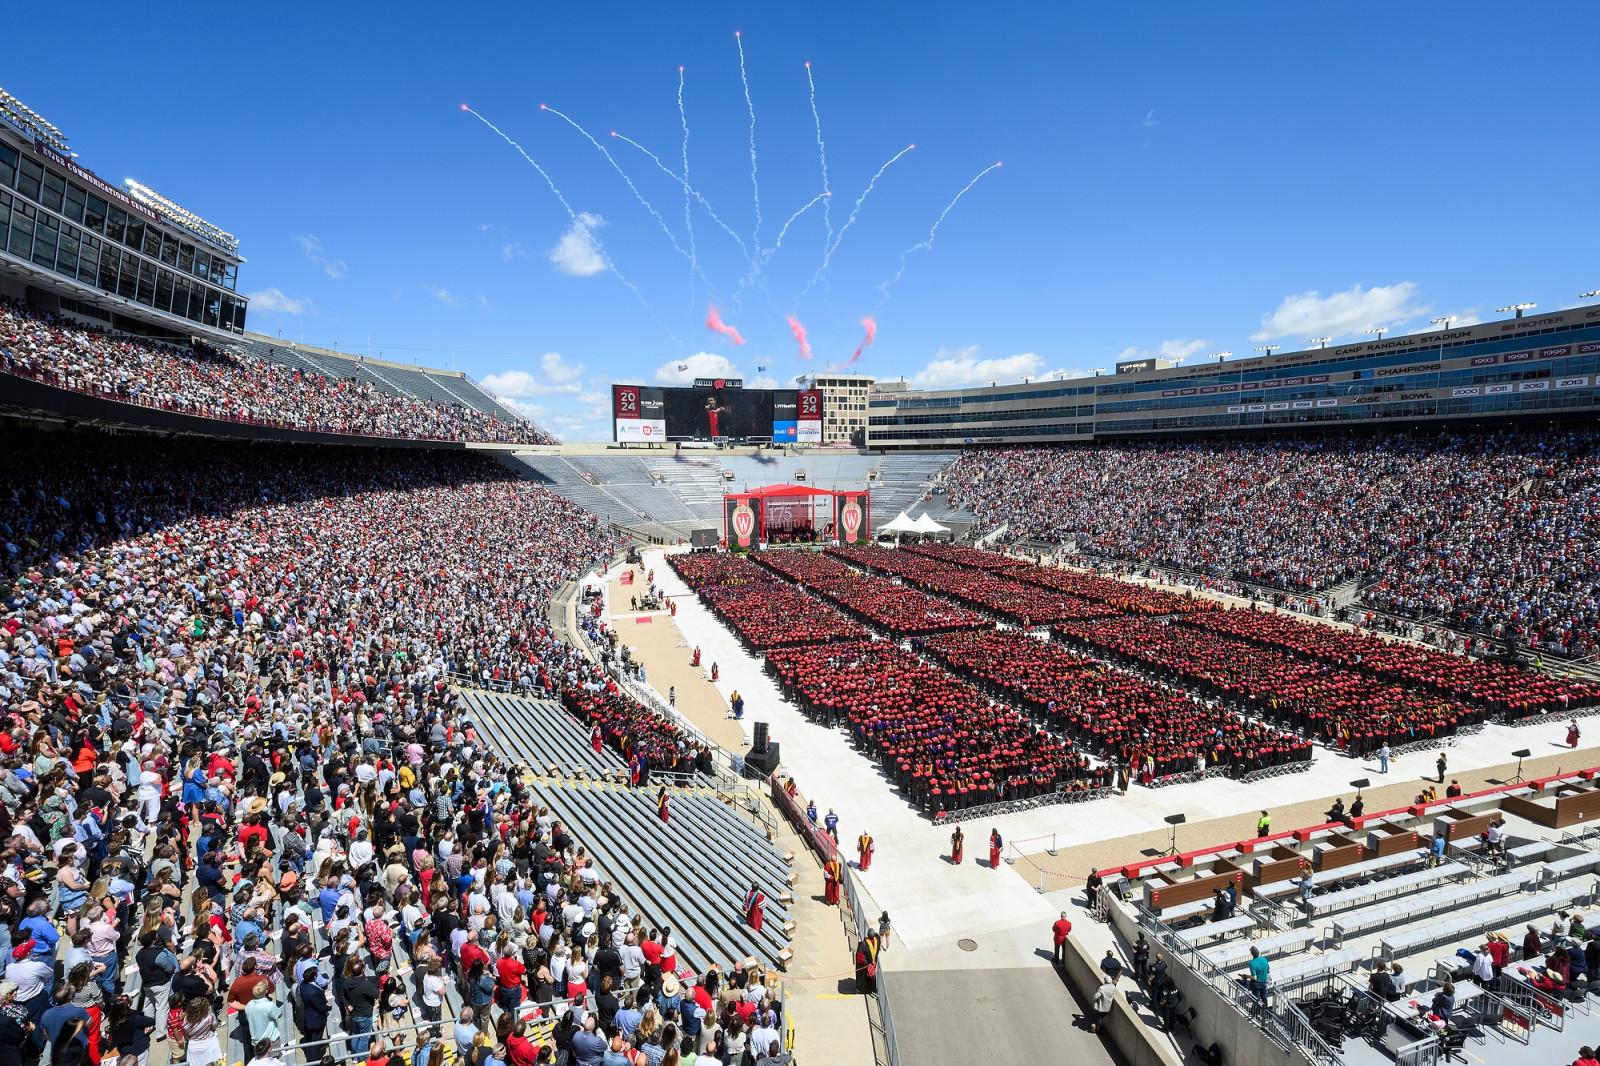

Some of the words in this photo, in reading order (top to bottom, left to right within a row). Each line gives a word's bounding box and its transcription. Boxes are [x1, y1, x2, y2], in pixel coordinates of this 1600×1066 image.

[67, 162, 130, 204] COMMUNICATIONS
[130, 198, 156, 219] CENTER
[1517, 316, 1564, 329] RICHTER
[1335, 346, 1362, 356] CAMP
[1367, 340, 1416, 351] RANDALL
[1421, 330, 1471, 344] STADIUM
[1543, 348, 1567, 356] 1999
[1377, 363, 1442, 376] CHAMPIONS
[1522, 382, 1545, 390] 2012
[621, 392, 636, 402] 20
[802, 395, 817, 405] 20
[1401, 392, 1433, 400] BOWL
[621, 402, 636, 411] 24
[802, 404, 817, 414] 24
[737, 515, 750, 533] W
[846, 511, 857, 529] W
